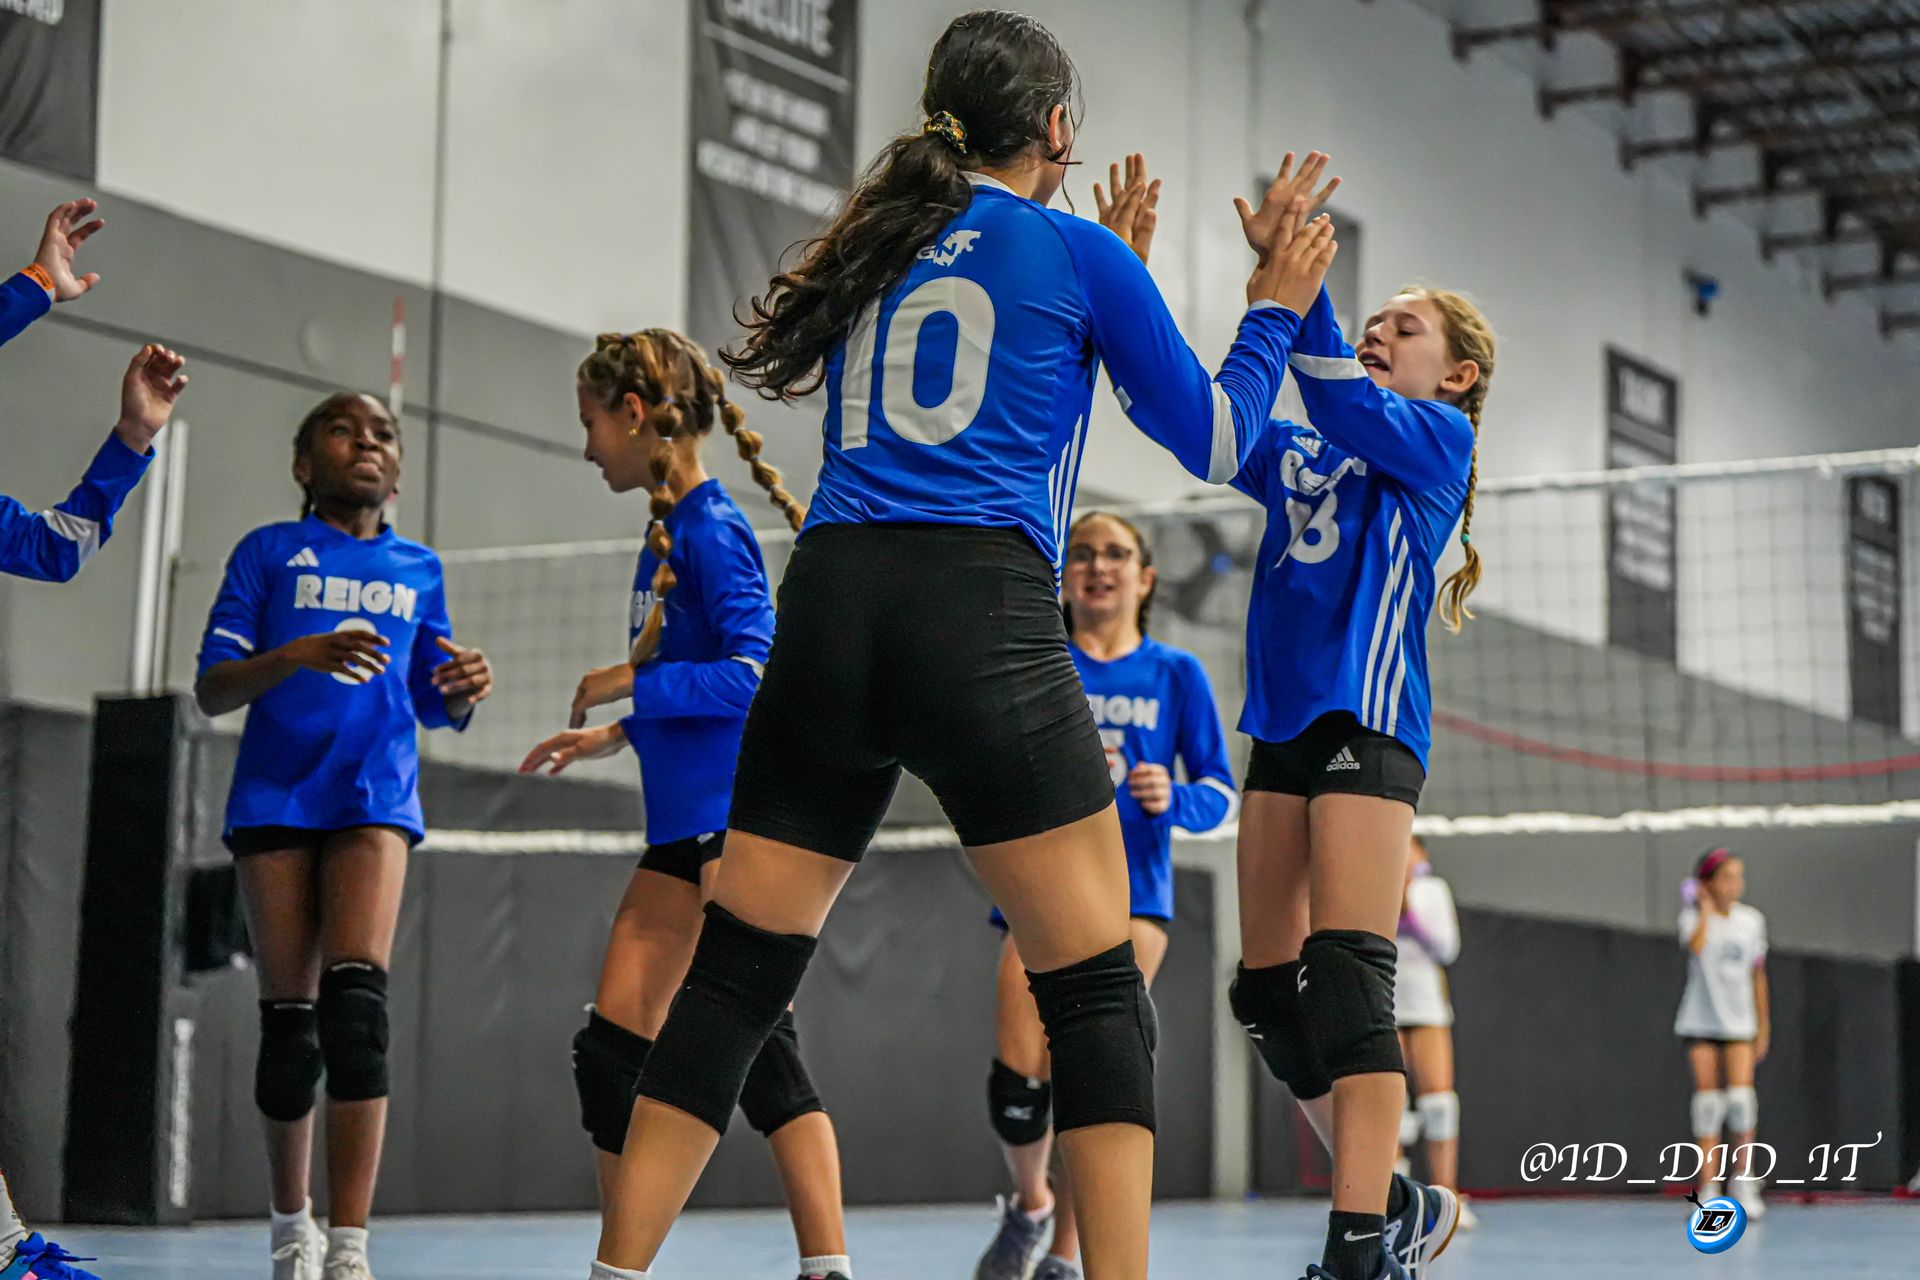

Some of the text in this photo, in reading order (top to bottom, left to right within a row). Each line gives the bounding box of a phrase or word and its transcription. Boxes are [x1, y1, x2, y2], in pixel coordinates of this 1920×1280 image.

[841, 276, 995, 451] 10
[294, 574, 417, 622] REIGN
[1087, 693, 1160, 731] IGN
[1326, 762, 1360, 772] adidas
